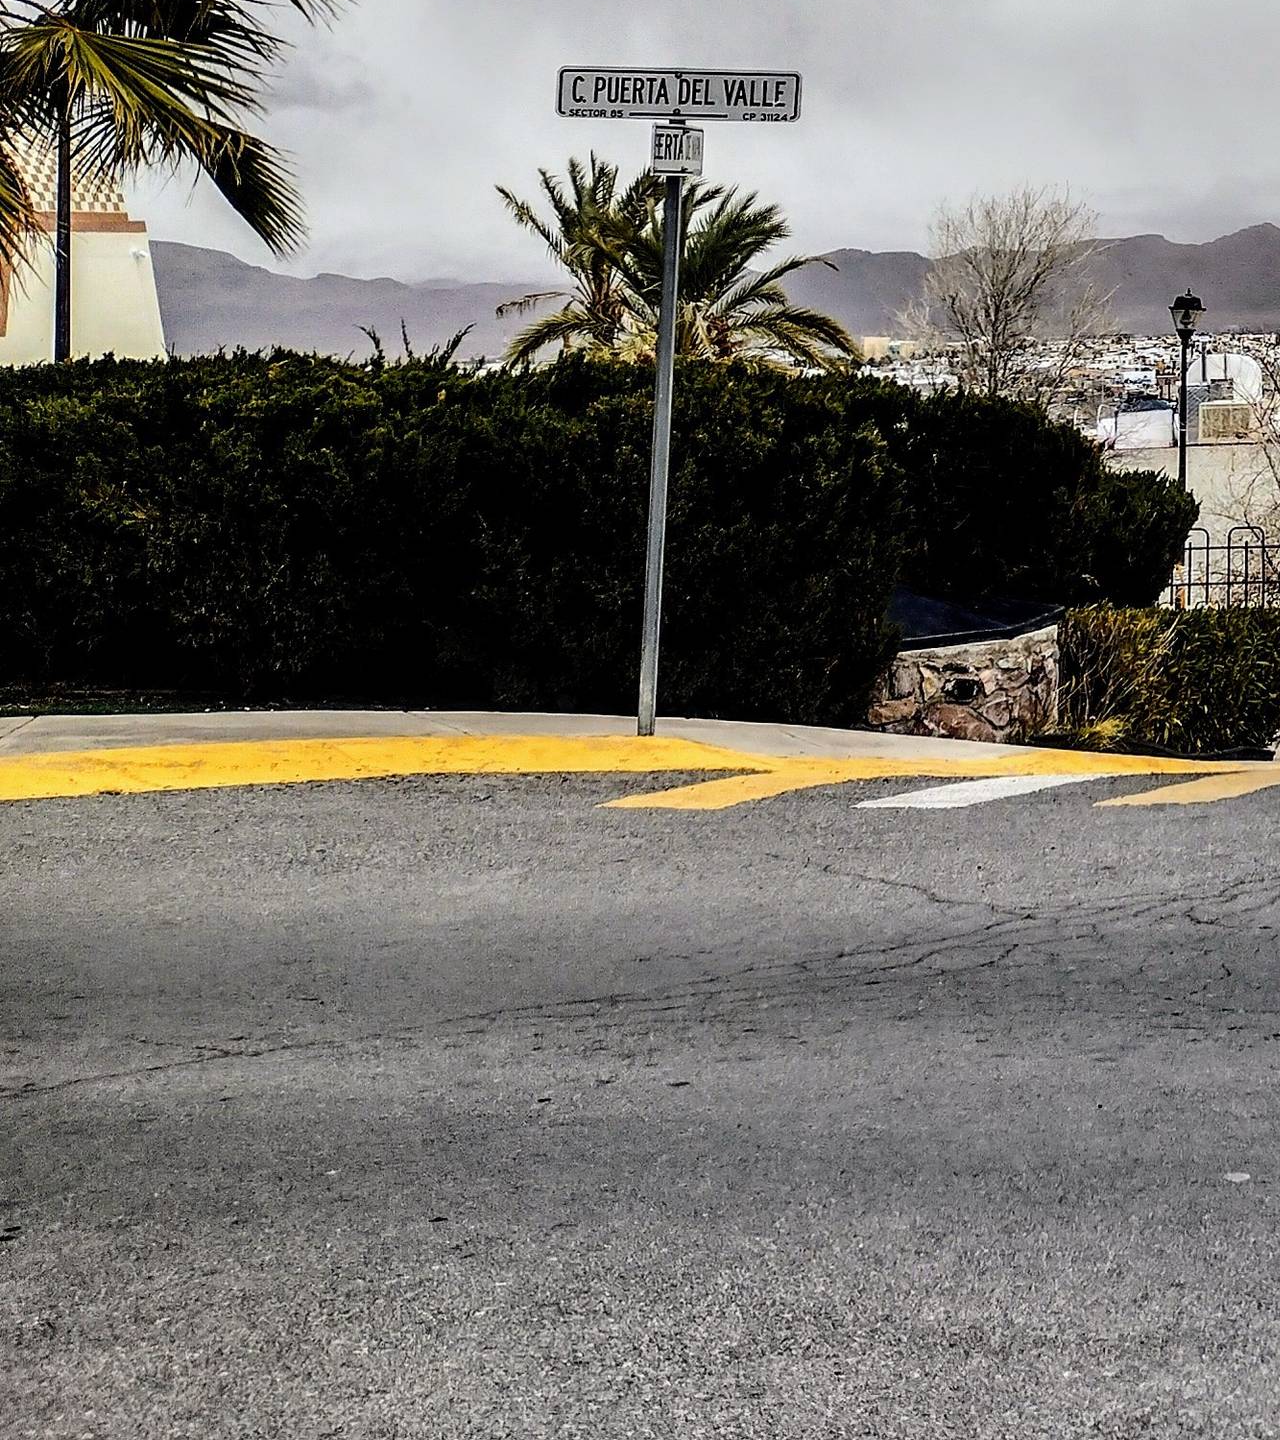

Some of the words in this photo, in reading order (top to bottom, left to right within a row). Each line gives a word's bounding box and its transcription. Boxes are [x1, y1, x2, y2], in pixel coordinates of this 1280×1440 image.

[593, 76, 670, 105] PUERTA
[677, 78, 716, 106] DEL
[723, 79, 787, 107] VALLE
[568, 108, 607, 118] SECTOR
[742, 112, 756, 121] CP
[760, 112, 788, 122] 31124
